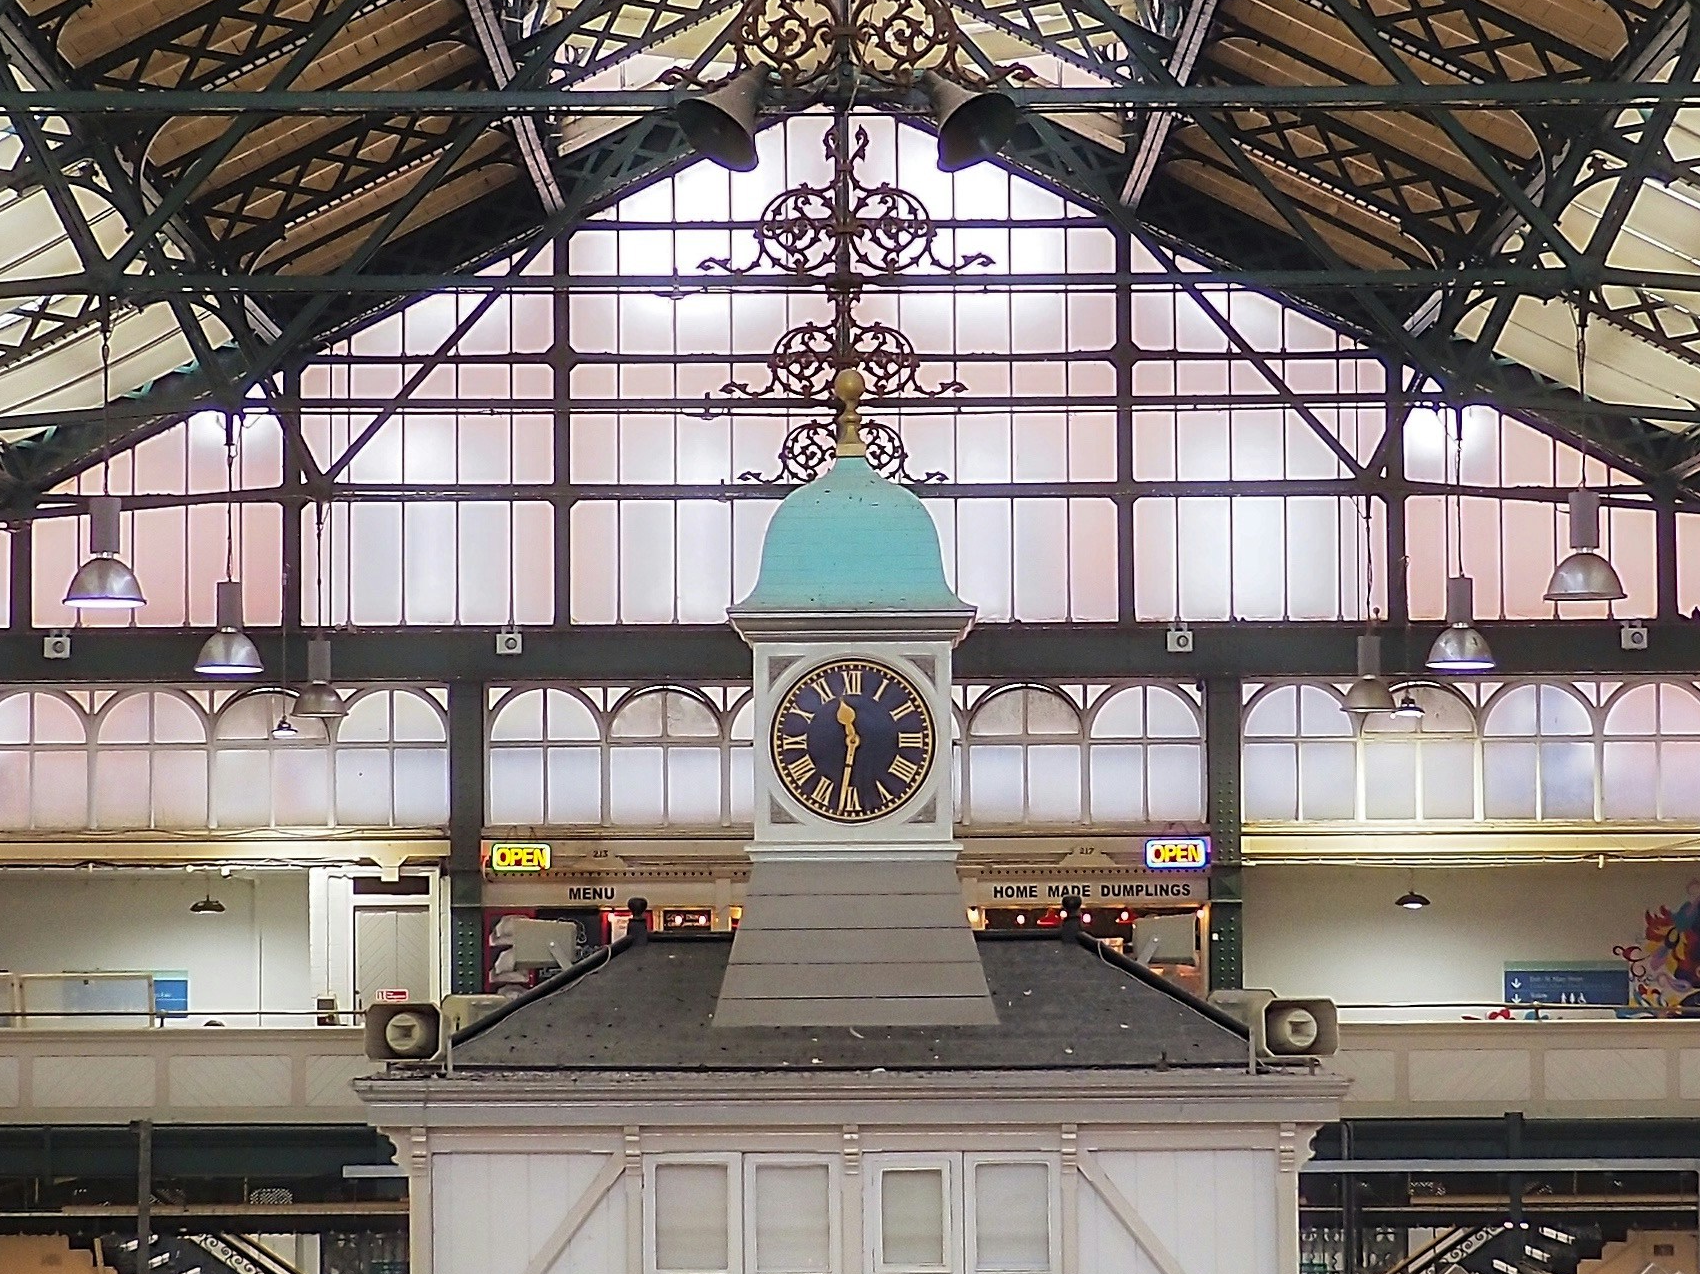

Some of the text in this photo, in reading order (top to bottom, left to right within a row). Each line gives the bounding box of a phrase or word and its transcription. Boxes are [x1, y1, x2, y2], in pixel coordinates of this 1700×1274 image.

[496, 846, 549, 869] OPEN
[1150, 844, 1201, 863] OPEN
[569, 886, 615, 901] MENU
[993, 882, 1192, 899] HOME MADE DUMPLINGS
